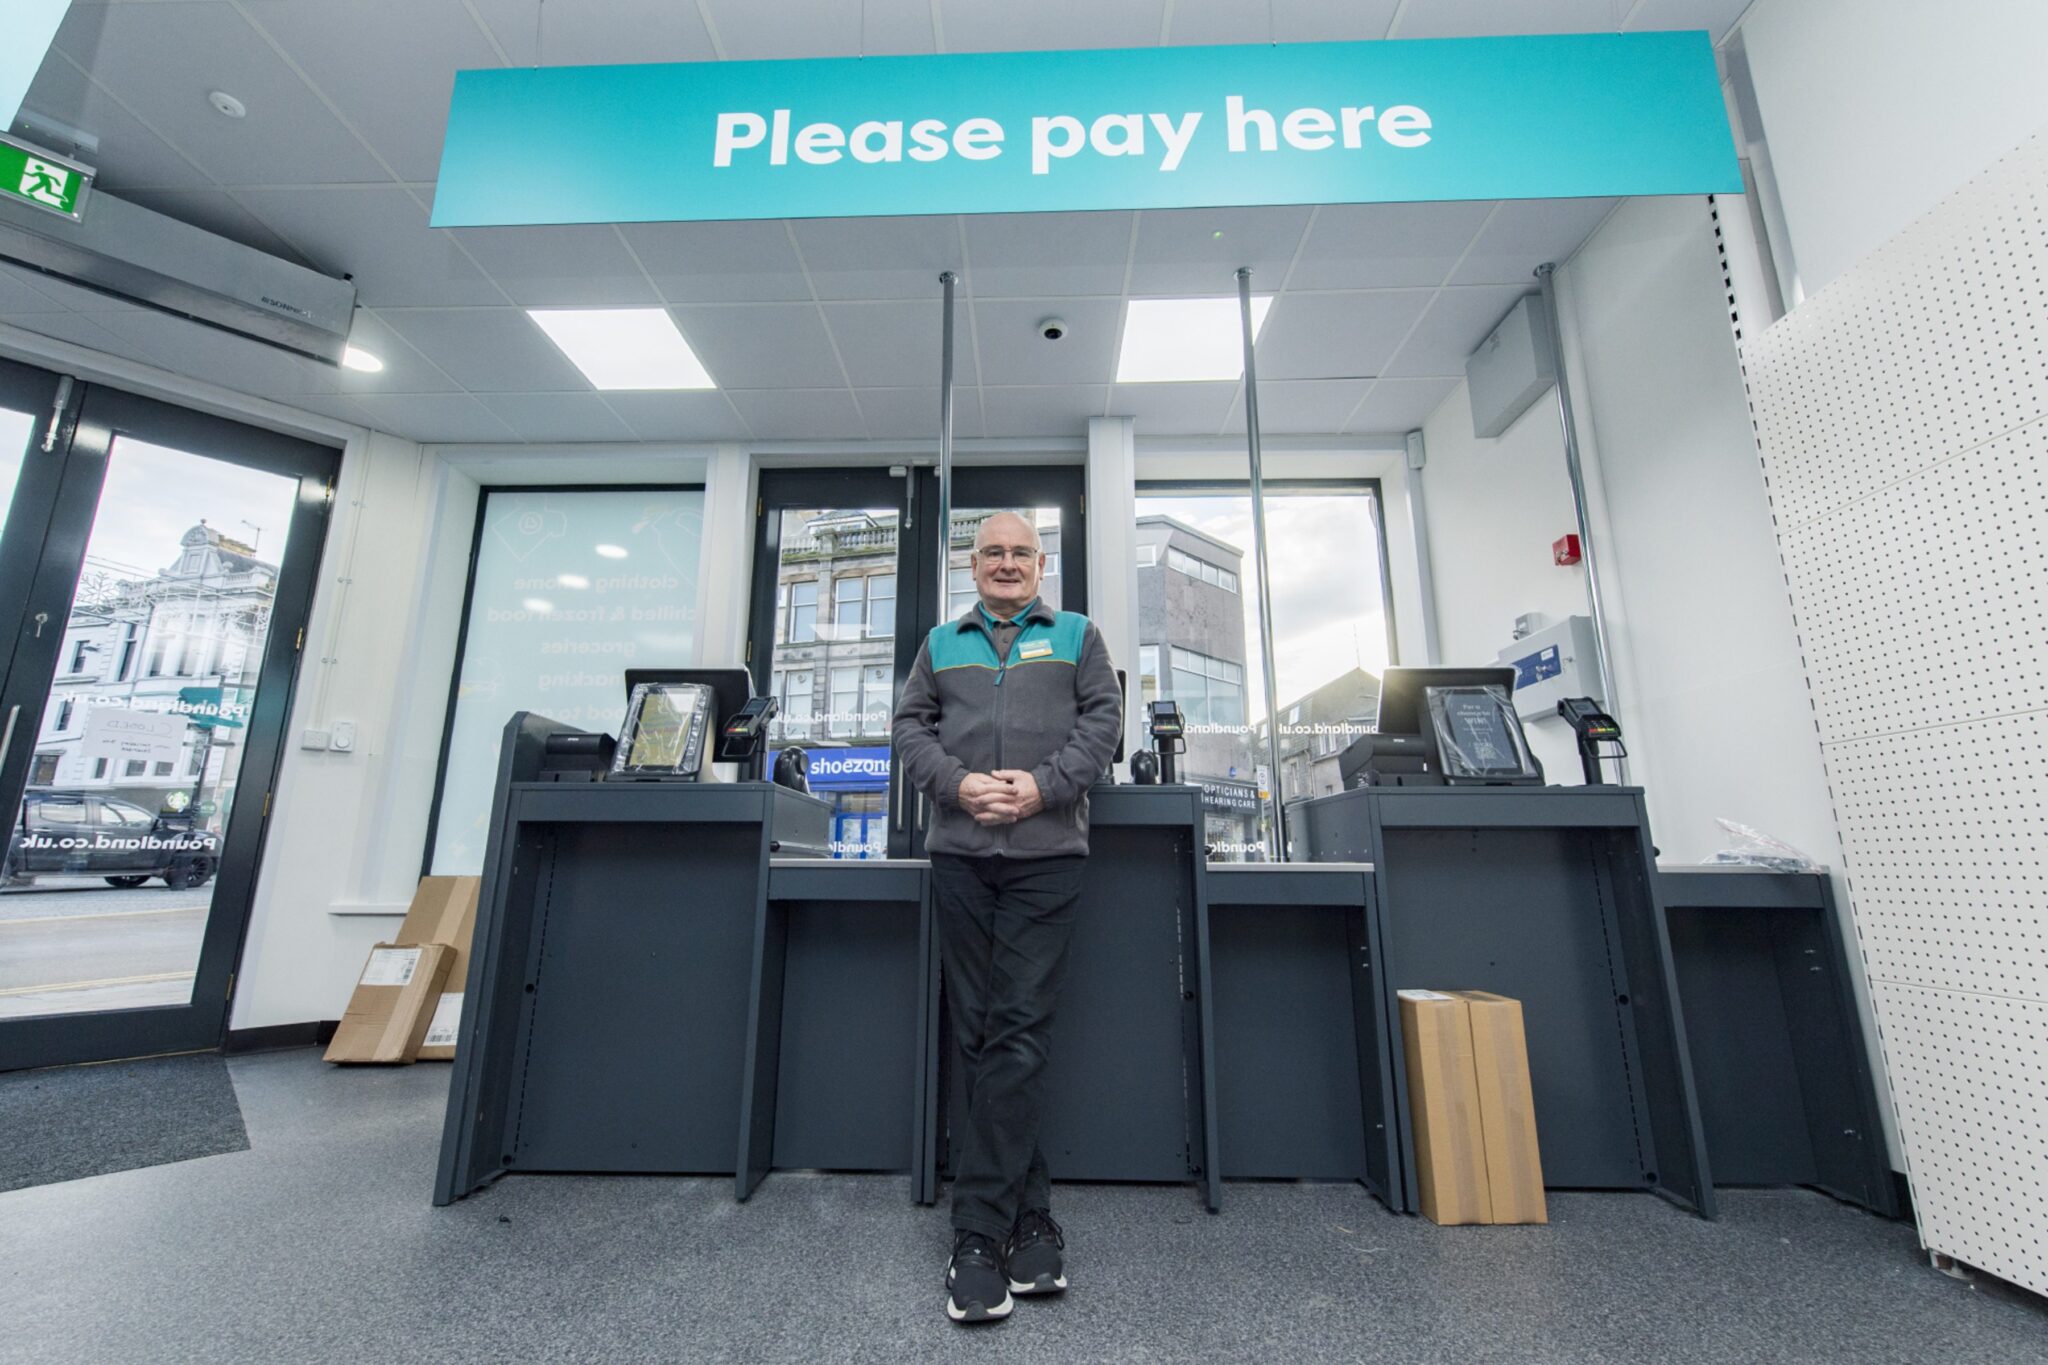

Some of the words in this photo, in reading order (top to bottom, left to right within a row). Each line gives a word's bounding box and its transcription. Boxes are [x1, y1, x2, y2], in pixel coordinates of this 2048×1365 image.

[713, 109, 1005, 169] Please
[1031, 111, 1203, 175] pay
[1225, 95, 1433, 153] here
[1204, 783, 1249, 800] OPTICIANS
[1249, 790, 1256, 800] &
[1204, 796, 1237, 807] HEARING
[1237, 798, 1257, 809] CARE
